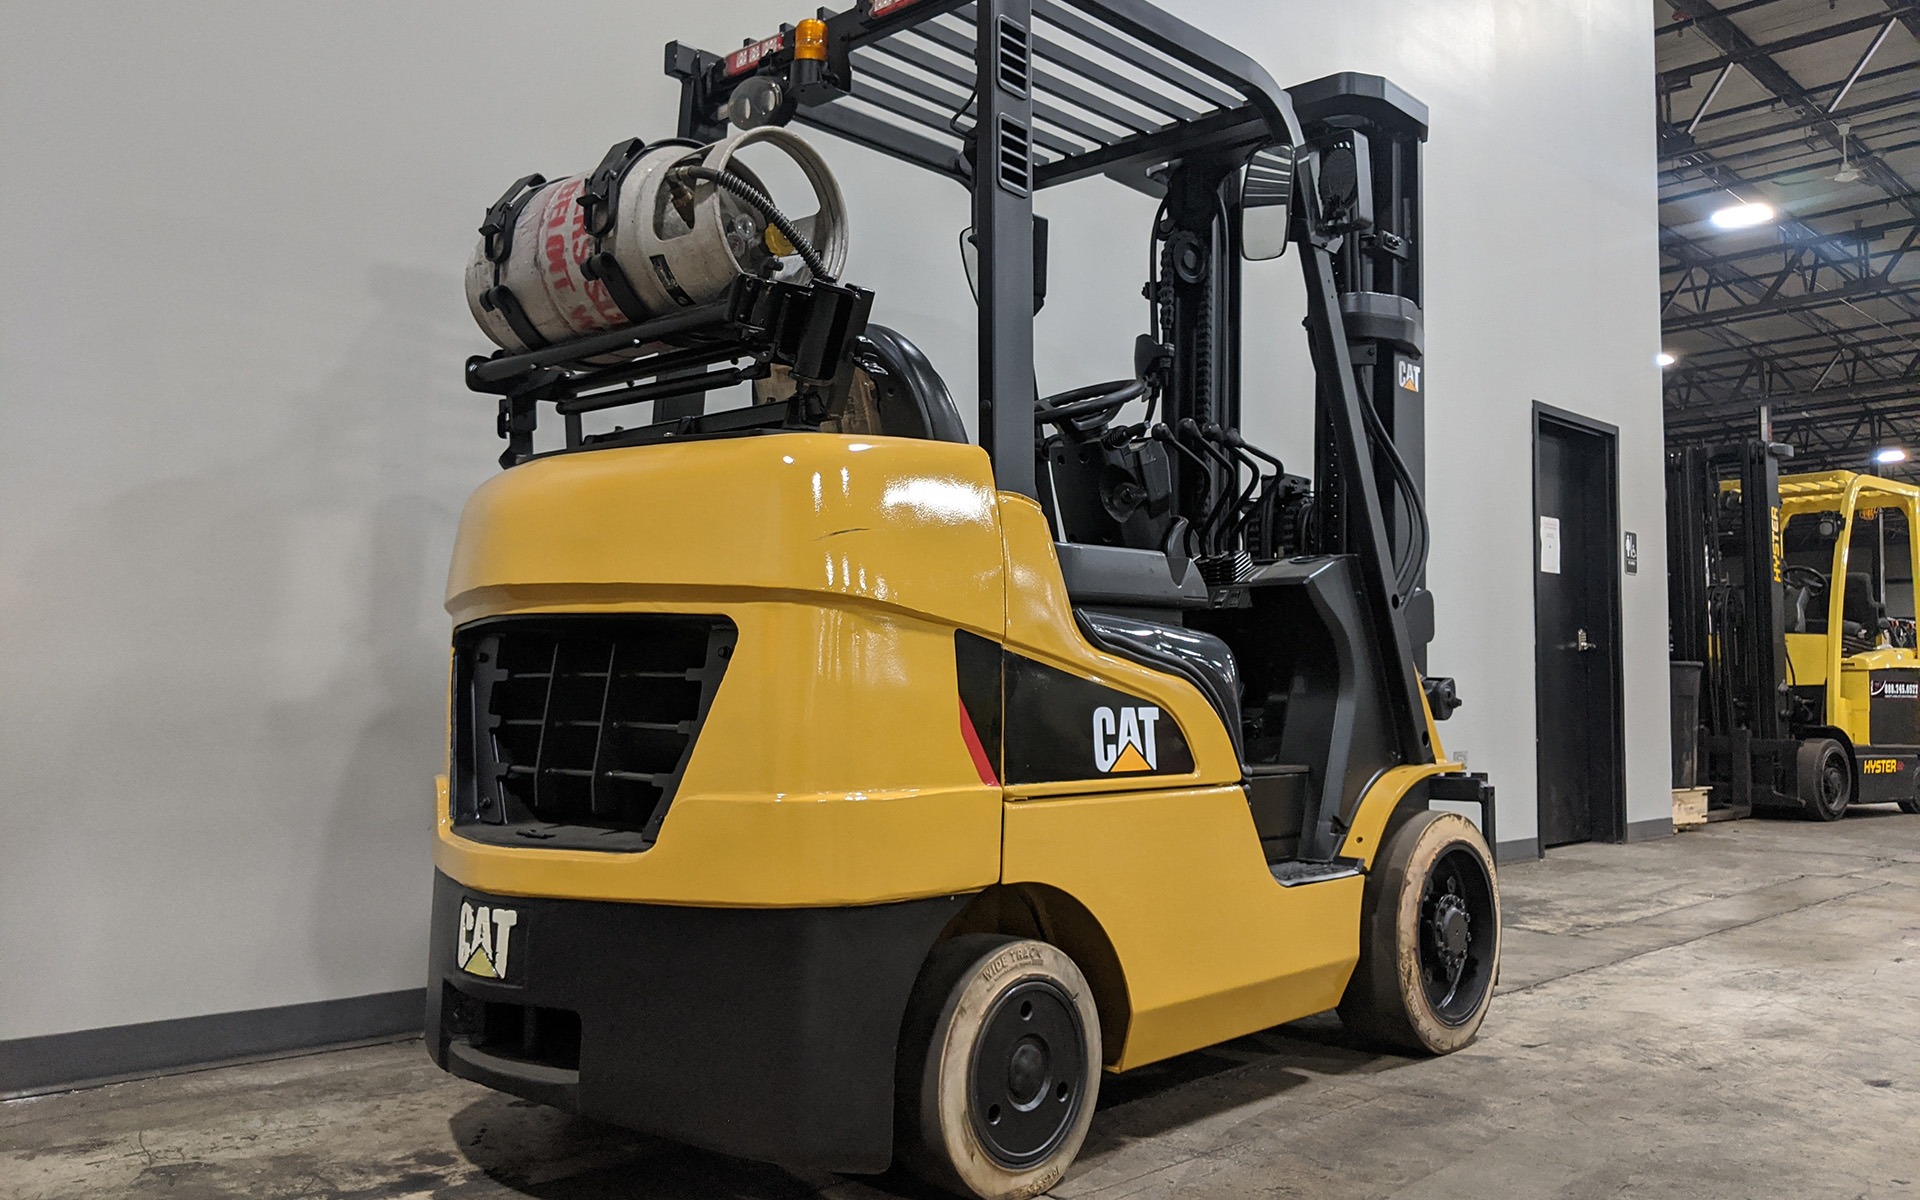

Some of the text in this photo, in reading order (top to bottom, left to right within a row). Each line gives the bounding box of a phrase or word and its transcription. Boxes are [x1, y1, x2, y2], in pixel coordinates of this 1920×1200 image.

[1398, 360, 1421, 393] CAT
[1770, 506, 1782, 583] HYSTER
[1093, 706, 1160, 773] CAT
[1863, 759, 1897, 774] HYSTER
[457, 901, 518, 979] CAT
[982, 955, 1008, 982] WIDE
